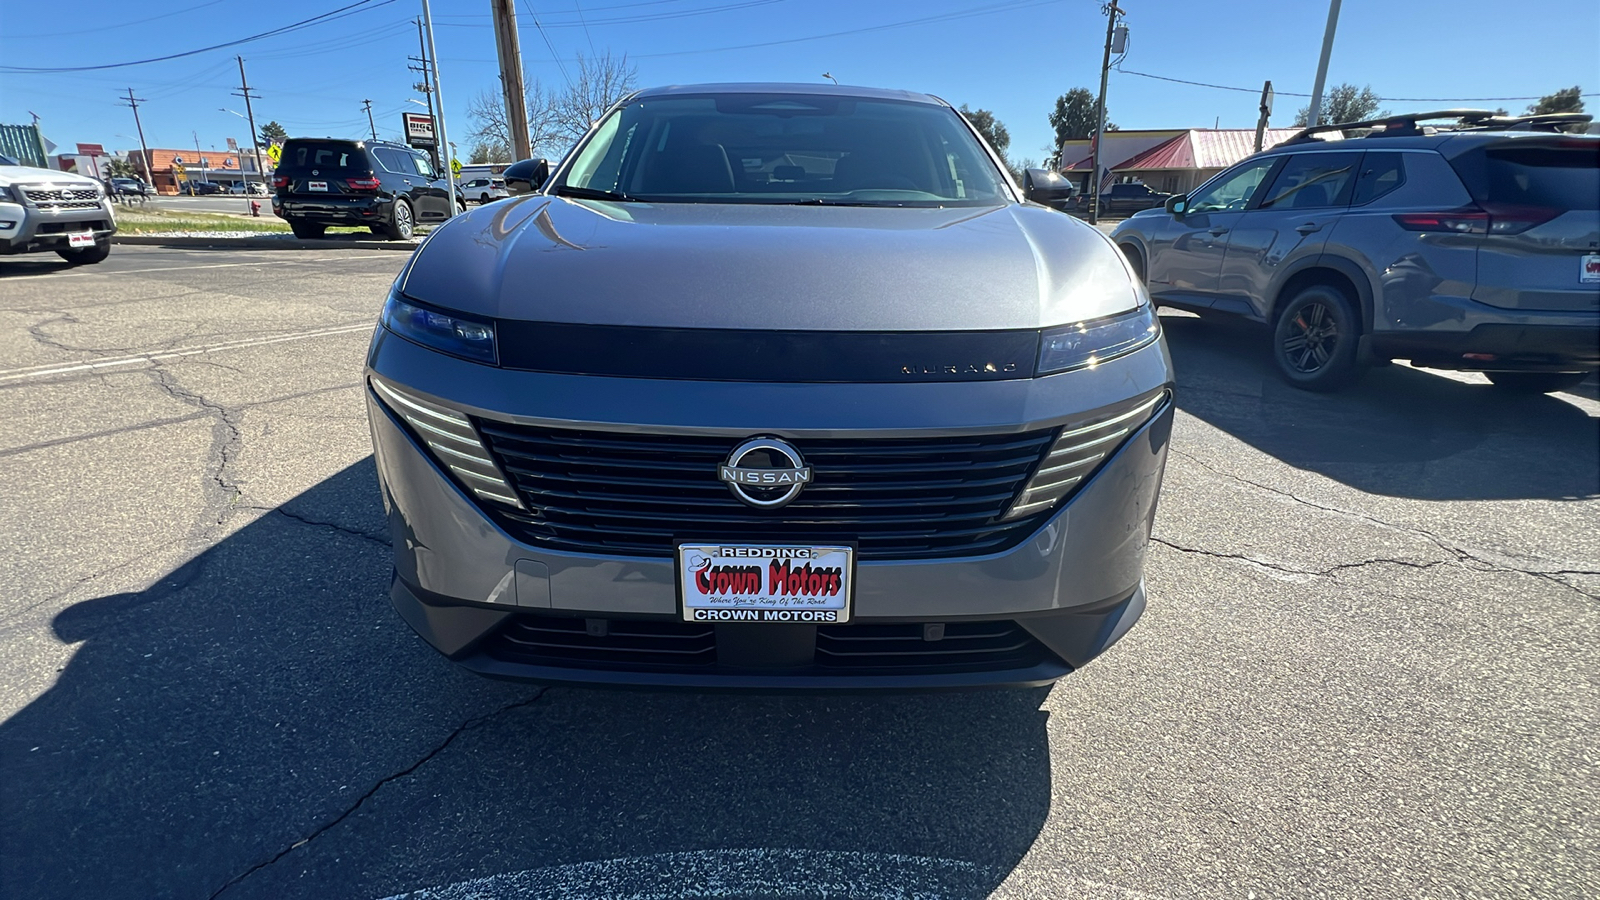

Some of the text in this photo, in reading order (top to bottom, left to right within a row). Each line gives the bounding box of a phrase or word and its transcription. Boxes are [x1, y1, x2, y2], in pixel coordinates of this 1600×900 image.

[723, 468, 808, 483] NISSAN
[721, 547, 811, 558] REDDING
[695, 557, 843, 597] Crown Motors
[709, 596, 731, 604] Where
[759, 597, 777, 606] King
[779, 597, 789, 607] Of
[791, 597, 805, 605] The
[806, 597, 827, 605] Road
[694, 609, 837, 621] CROWN MOTORS
